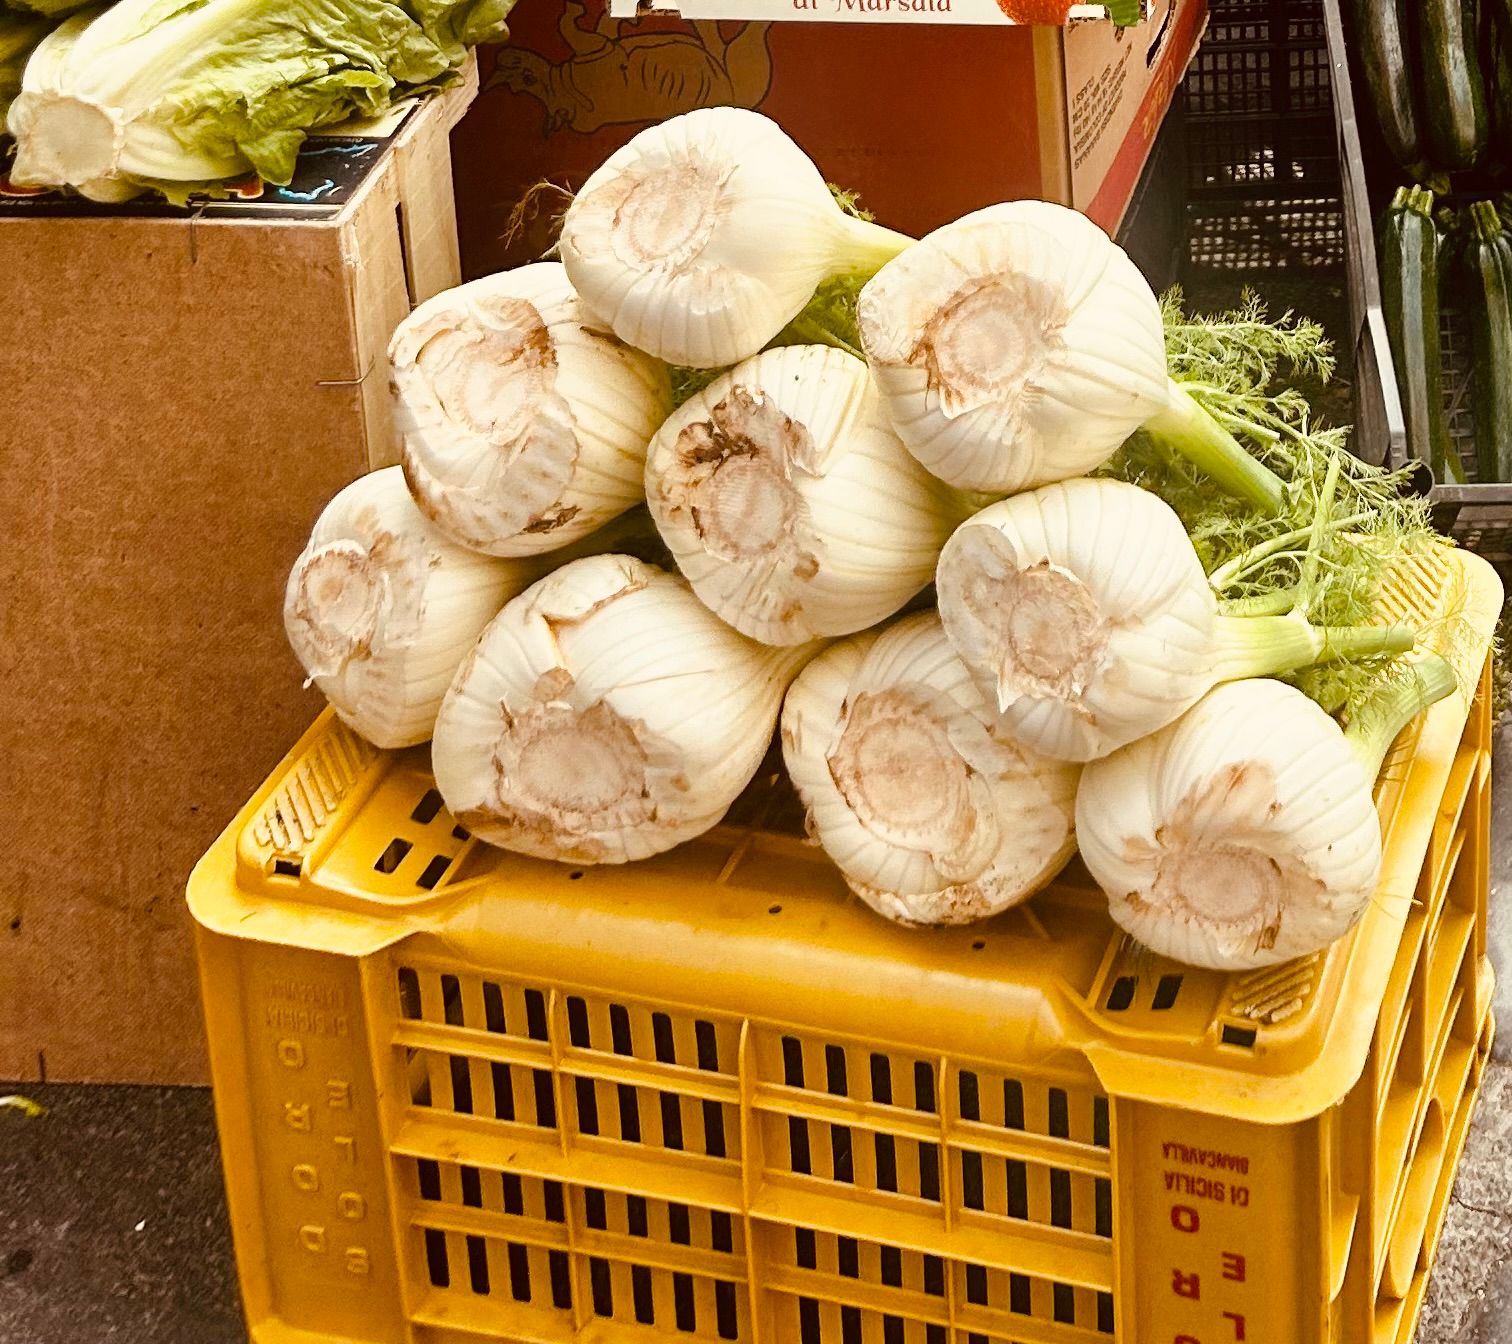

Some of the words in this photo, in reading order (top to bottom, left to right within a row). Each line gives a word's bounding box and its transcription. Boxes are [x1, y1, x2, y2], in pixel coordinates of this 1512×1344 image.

[1162, 1141, 1249, 1175] BIANCAVILLA
[1164, 1171, 1226, 1203] SICILIA
[1230, 1184, 1249, 1207] DI
